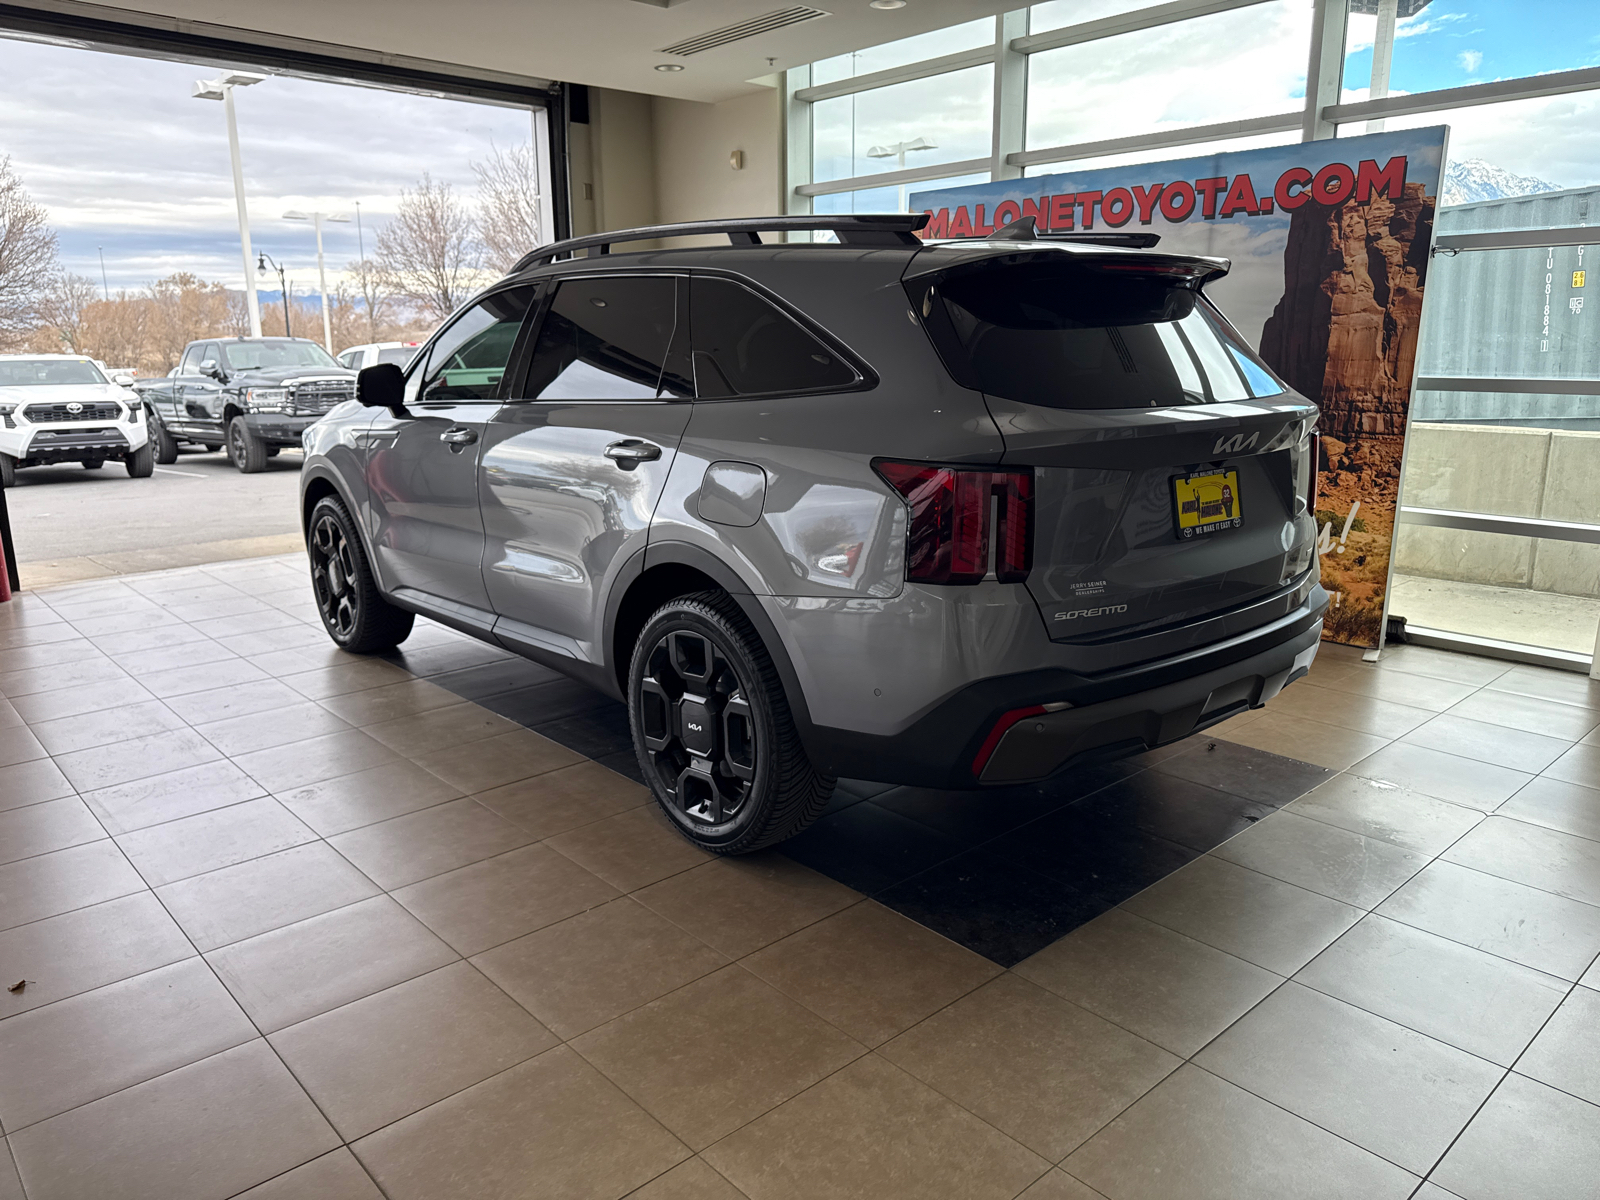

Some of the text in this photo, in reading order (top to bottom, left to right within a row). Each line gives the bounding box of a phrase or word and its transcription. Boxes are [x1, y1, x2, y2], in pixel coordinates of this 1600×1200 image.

[922, 155, 1408, 239] MALONETOYOTA.COM
[1543, 273, 1552, 336] 081884
[1223, 489, 1230, 498] 32
[1195, 527, 1203, 535] WE
[1203, 524, 1215, 533] MAKE
[1220, 520, 1231, 530] EASY
[1070, 580, 1107, 590] JERRY SEINER
[1054, 604, 1127, 621] SORENTO
